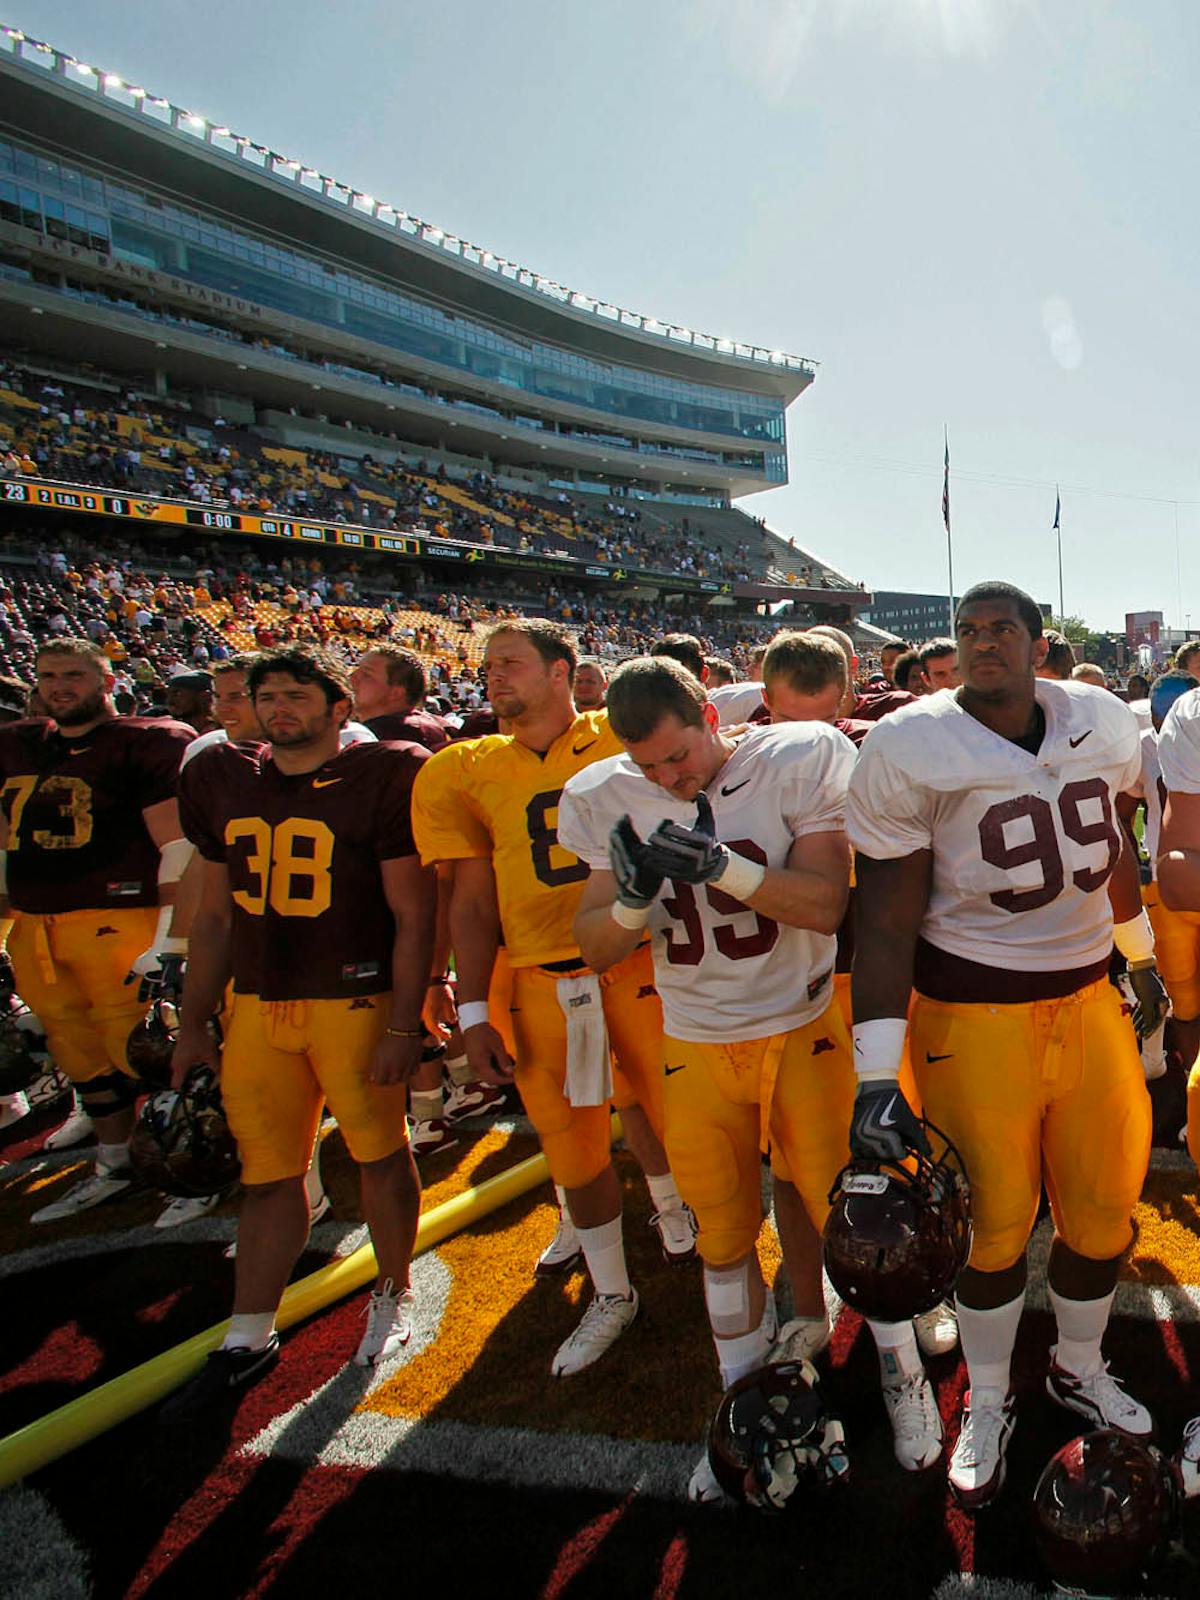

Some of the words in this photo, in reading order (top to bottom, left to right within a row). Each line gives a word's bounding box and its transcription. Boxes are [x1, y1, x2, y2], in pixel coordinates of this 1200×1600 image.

[4, 482, 25, 500] 23
[86, 496, 94, 508] 3
[112, 499, 122, 514] 0
[203, 512, 232, 528] 0:00
[283, 522, 292, 536] 4
[0, 774, 93, 850] 73
[978, 777, 1120, 914] 99
[225, 816, 335, 917] 38
